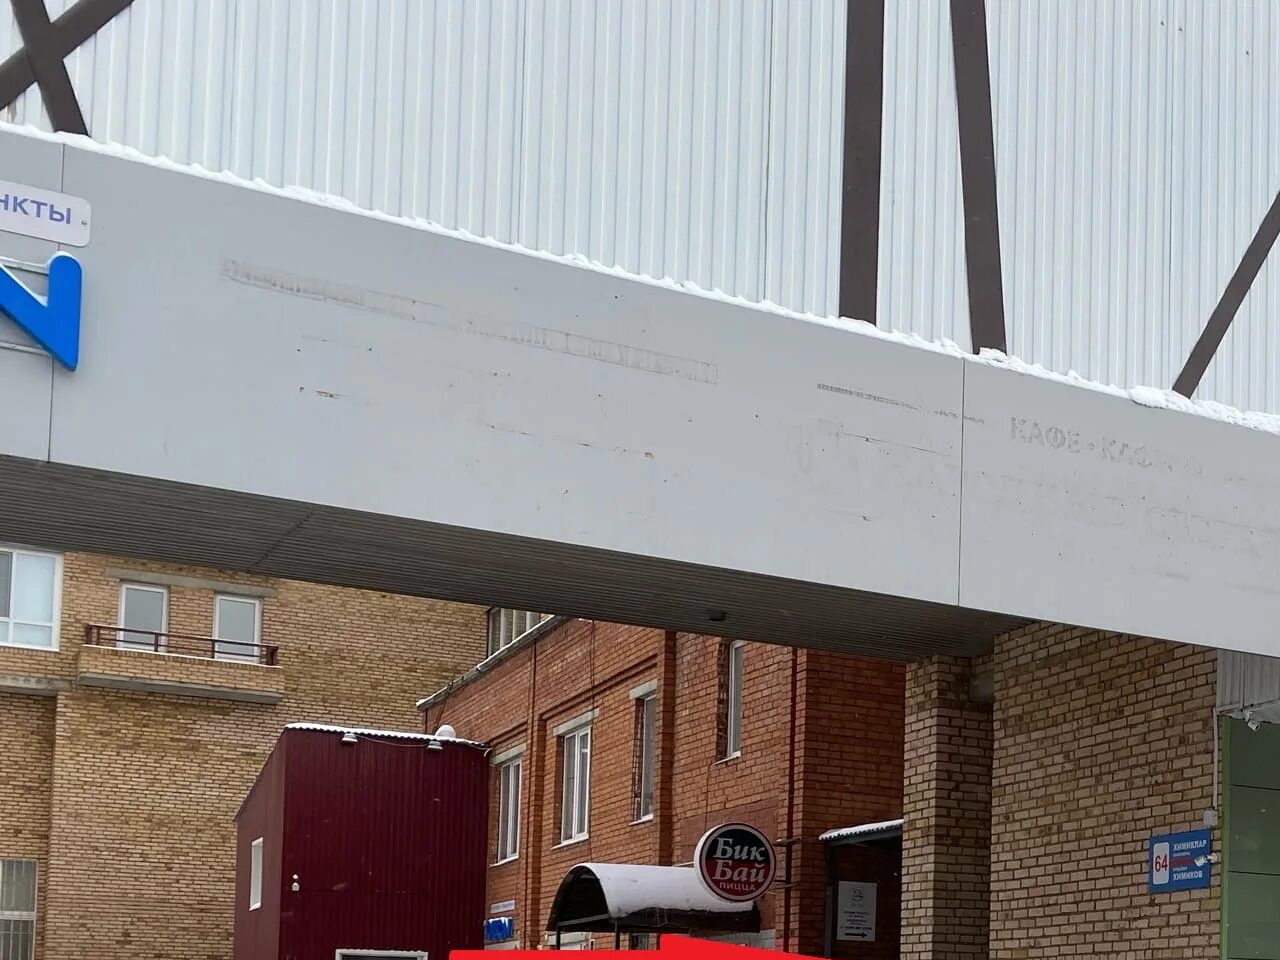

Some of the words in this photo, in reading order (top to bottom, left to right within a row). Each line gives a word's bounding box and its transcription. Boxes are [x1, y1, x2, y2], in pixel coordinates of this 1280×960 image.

[713, 837, 766, 861] Бик
[1173, 840, 1207, 851] ХИМИКЛАР
[712, 859, 766, 882] Бай
[1155, 854, 1168, 873] 64
[1173, 871, 1203, 881] ХИМИКОВ
[719, 881, 756, 891] ПИЦЦА
